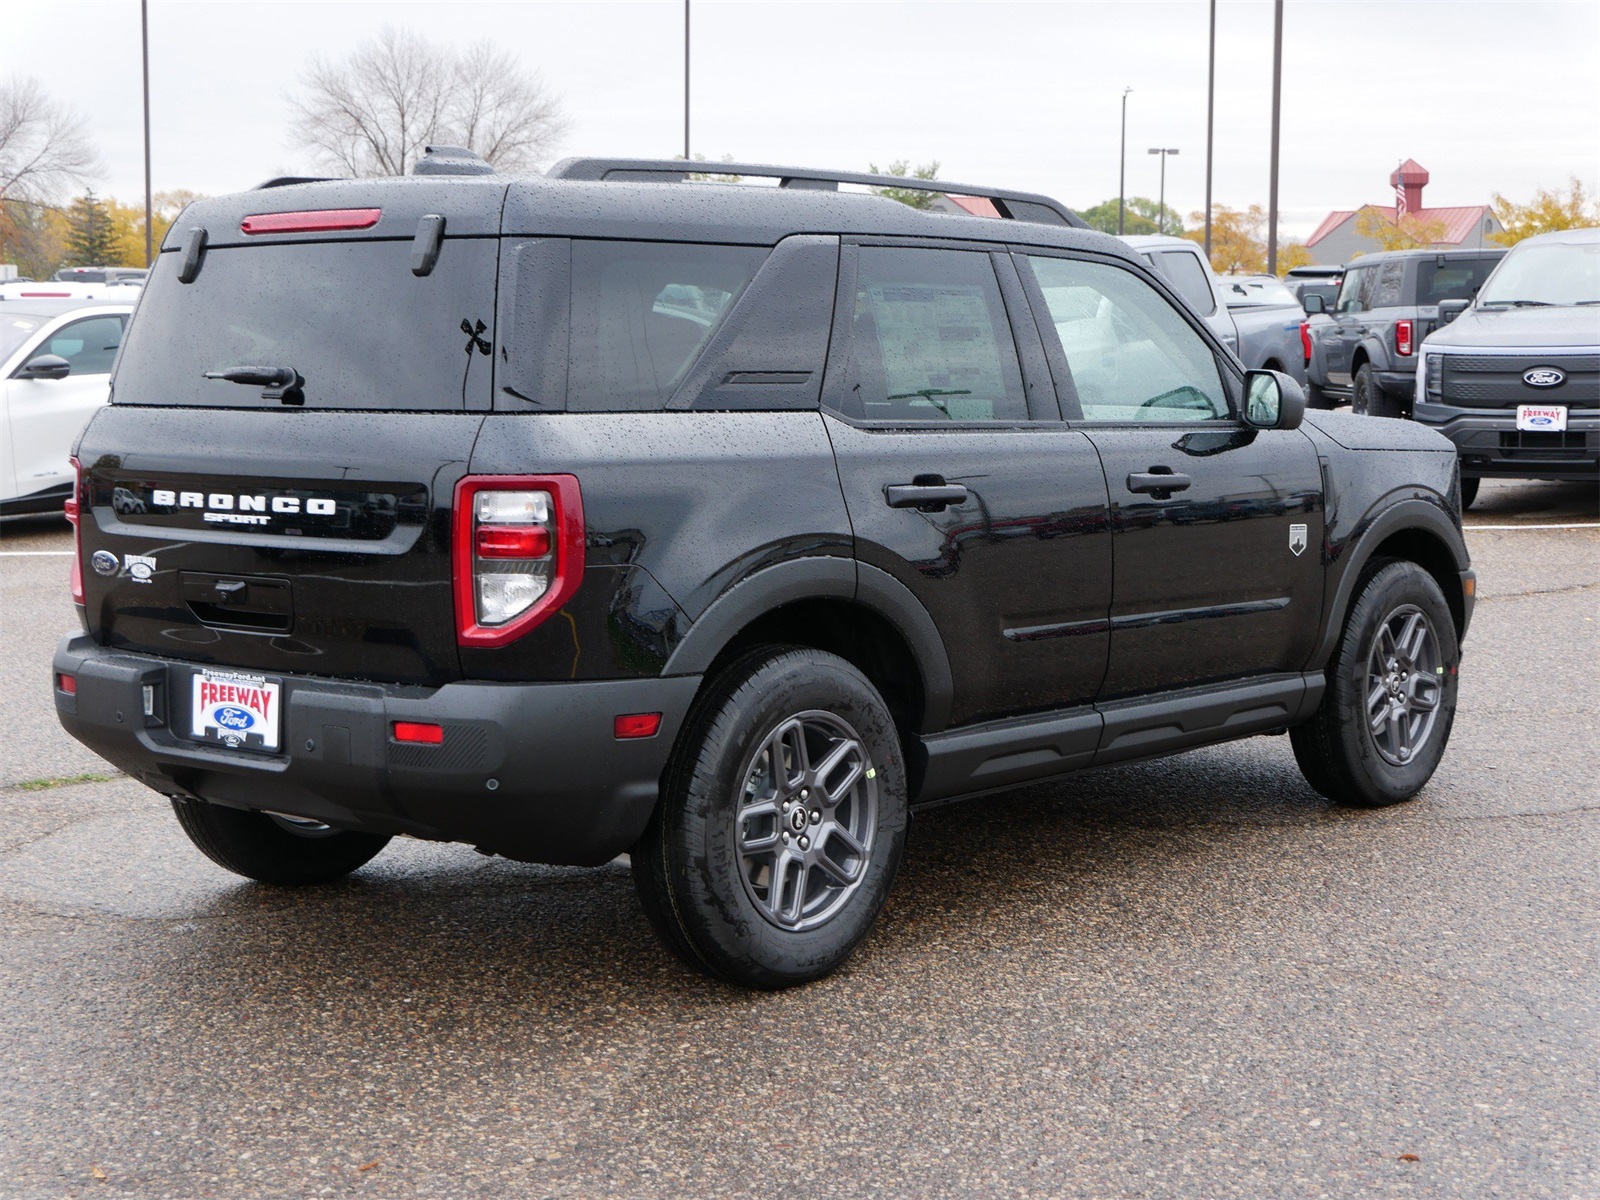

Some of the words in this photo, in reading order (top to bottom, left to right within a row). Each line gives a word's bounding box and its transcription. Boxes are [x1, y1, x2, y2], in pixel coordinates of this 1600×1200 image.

[1530, 371, 1556, 383] Ford
[1522, 410, 1561, 422] FREEWAY
[153, 489, 336, 515] BRONCO
[203, 512, 272, 525] SPORT
[124, 554, 157, 571] FREEWAY
[202, 669, 266, 683] FreewayFord.net
[201, 682, 272, 724] FREEWAY
[220, 708, 247, 728] Ford
